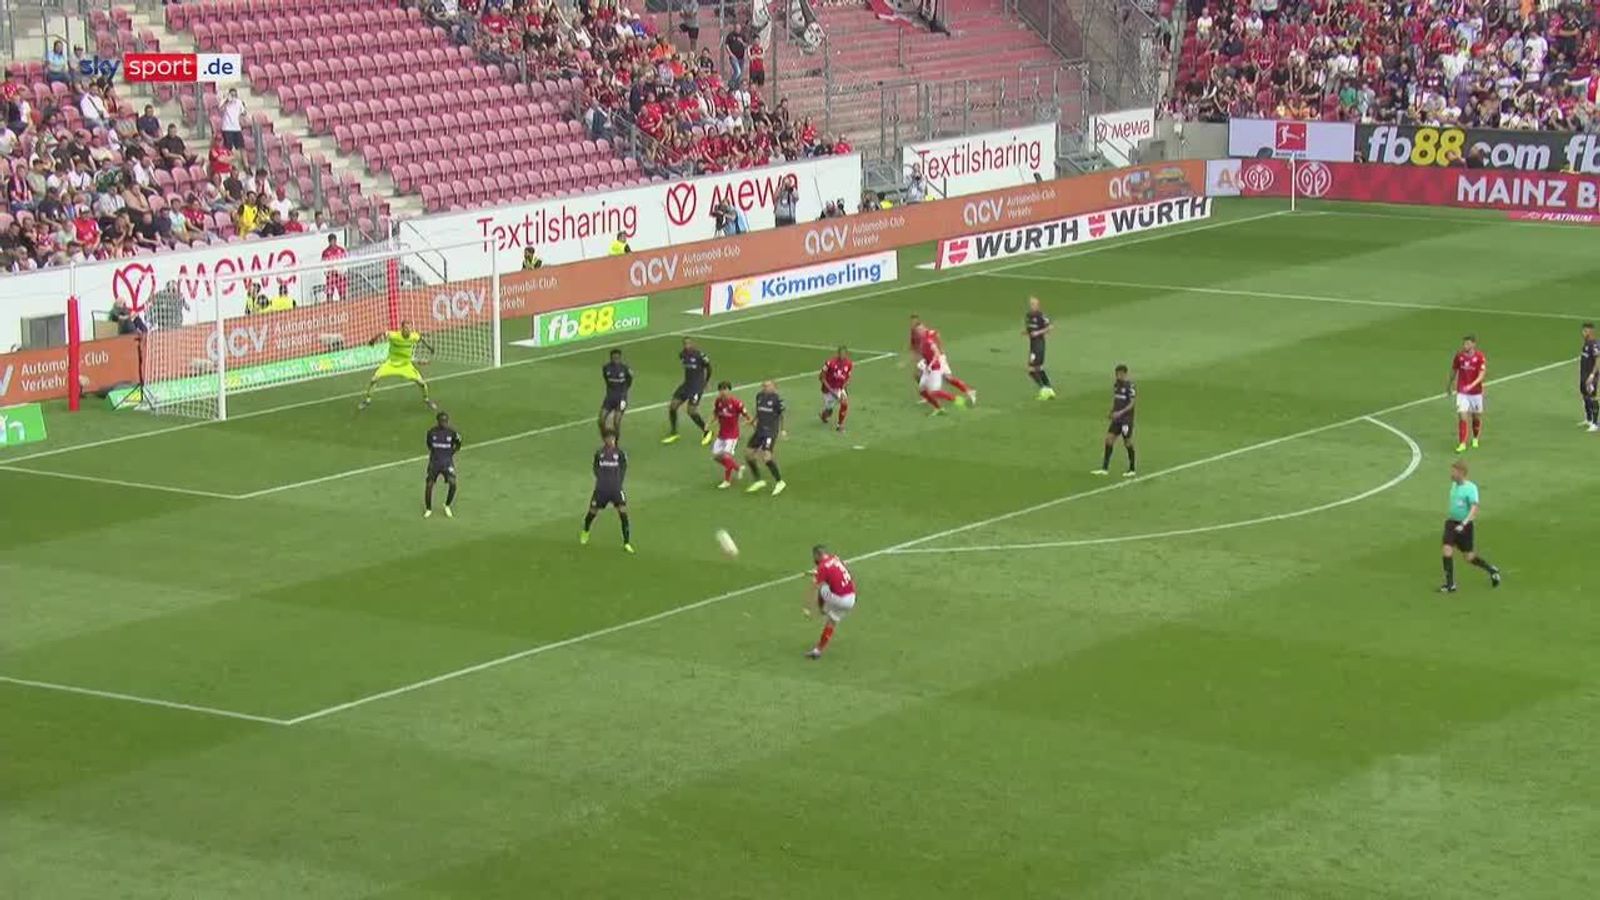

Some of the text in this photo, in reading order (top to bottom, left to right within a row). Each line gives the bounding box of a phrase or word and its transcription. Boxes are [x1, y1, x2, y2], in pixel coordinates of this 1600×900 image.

[917, 136, 1042, 182] Textilsharing
[1368, 123, 1551, 172] fb88com
[1457, 175, 1568, 208] MAINZ
[477, 201, 638, 253] Textilsharing
[1111, 197, 1207, 233] WÜRTH
[1541, 212, 1593, 223] PLATINUM
[976, 220, 1080, 260] WÜRTH
[761, 263, 882, 299] Kömmerling
[548, 306, 641, 341] fb88.com
